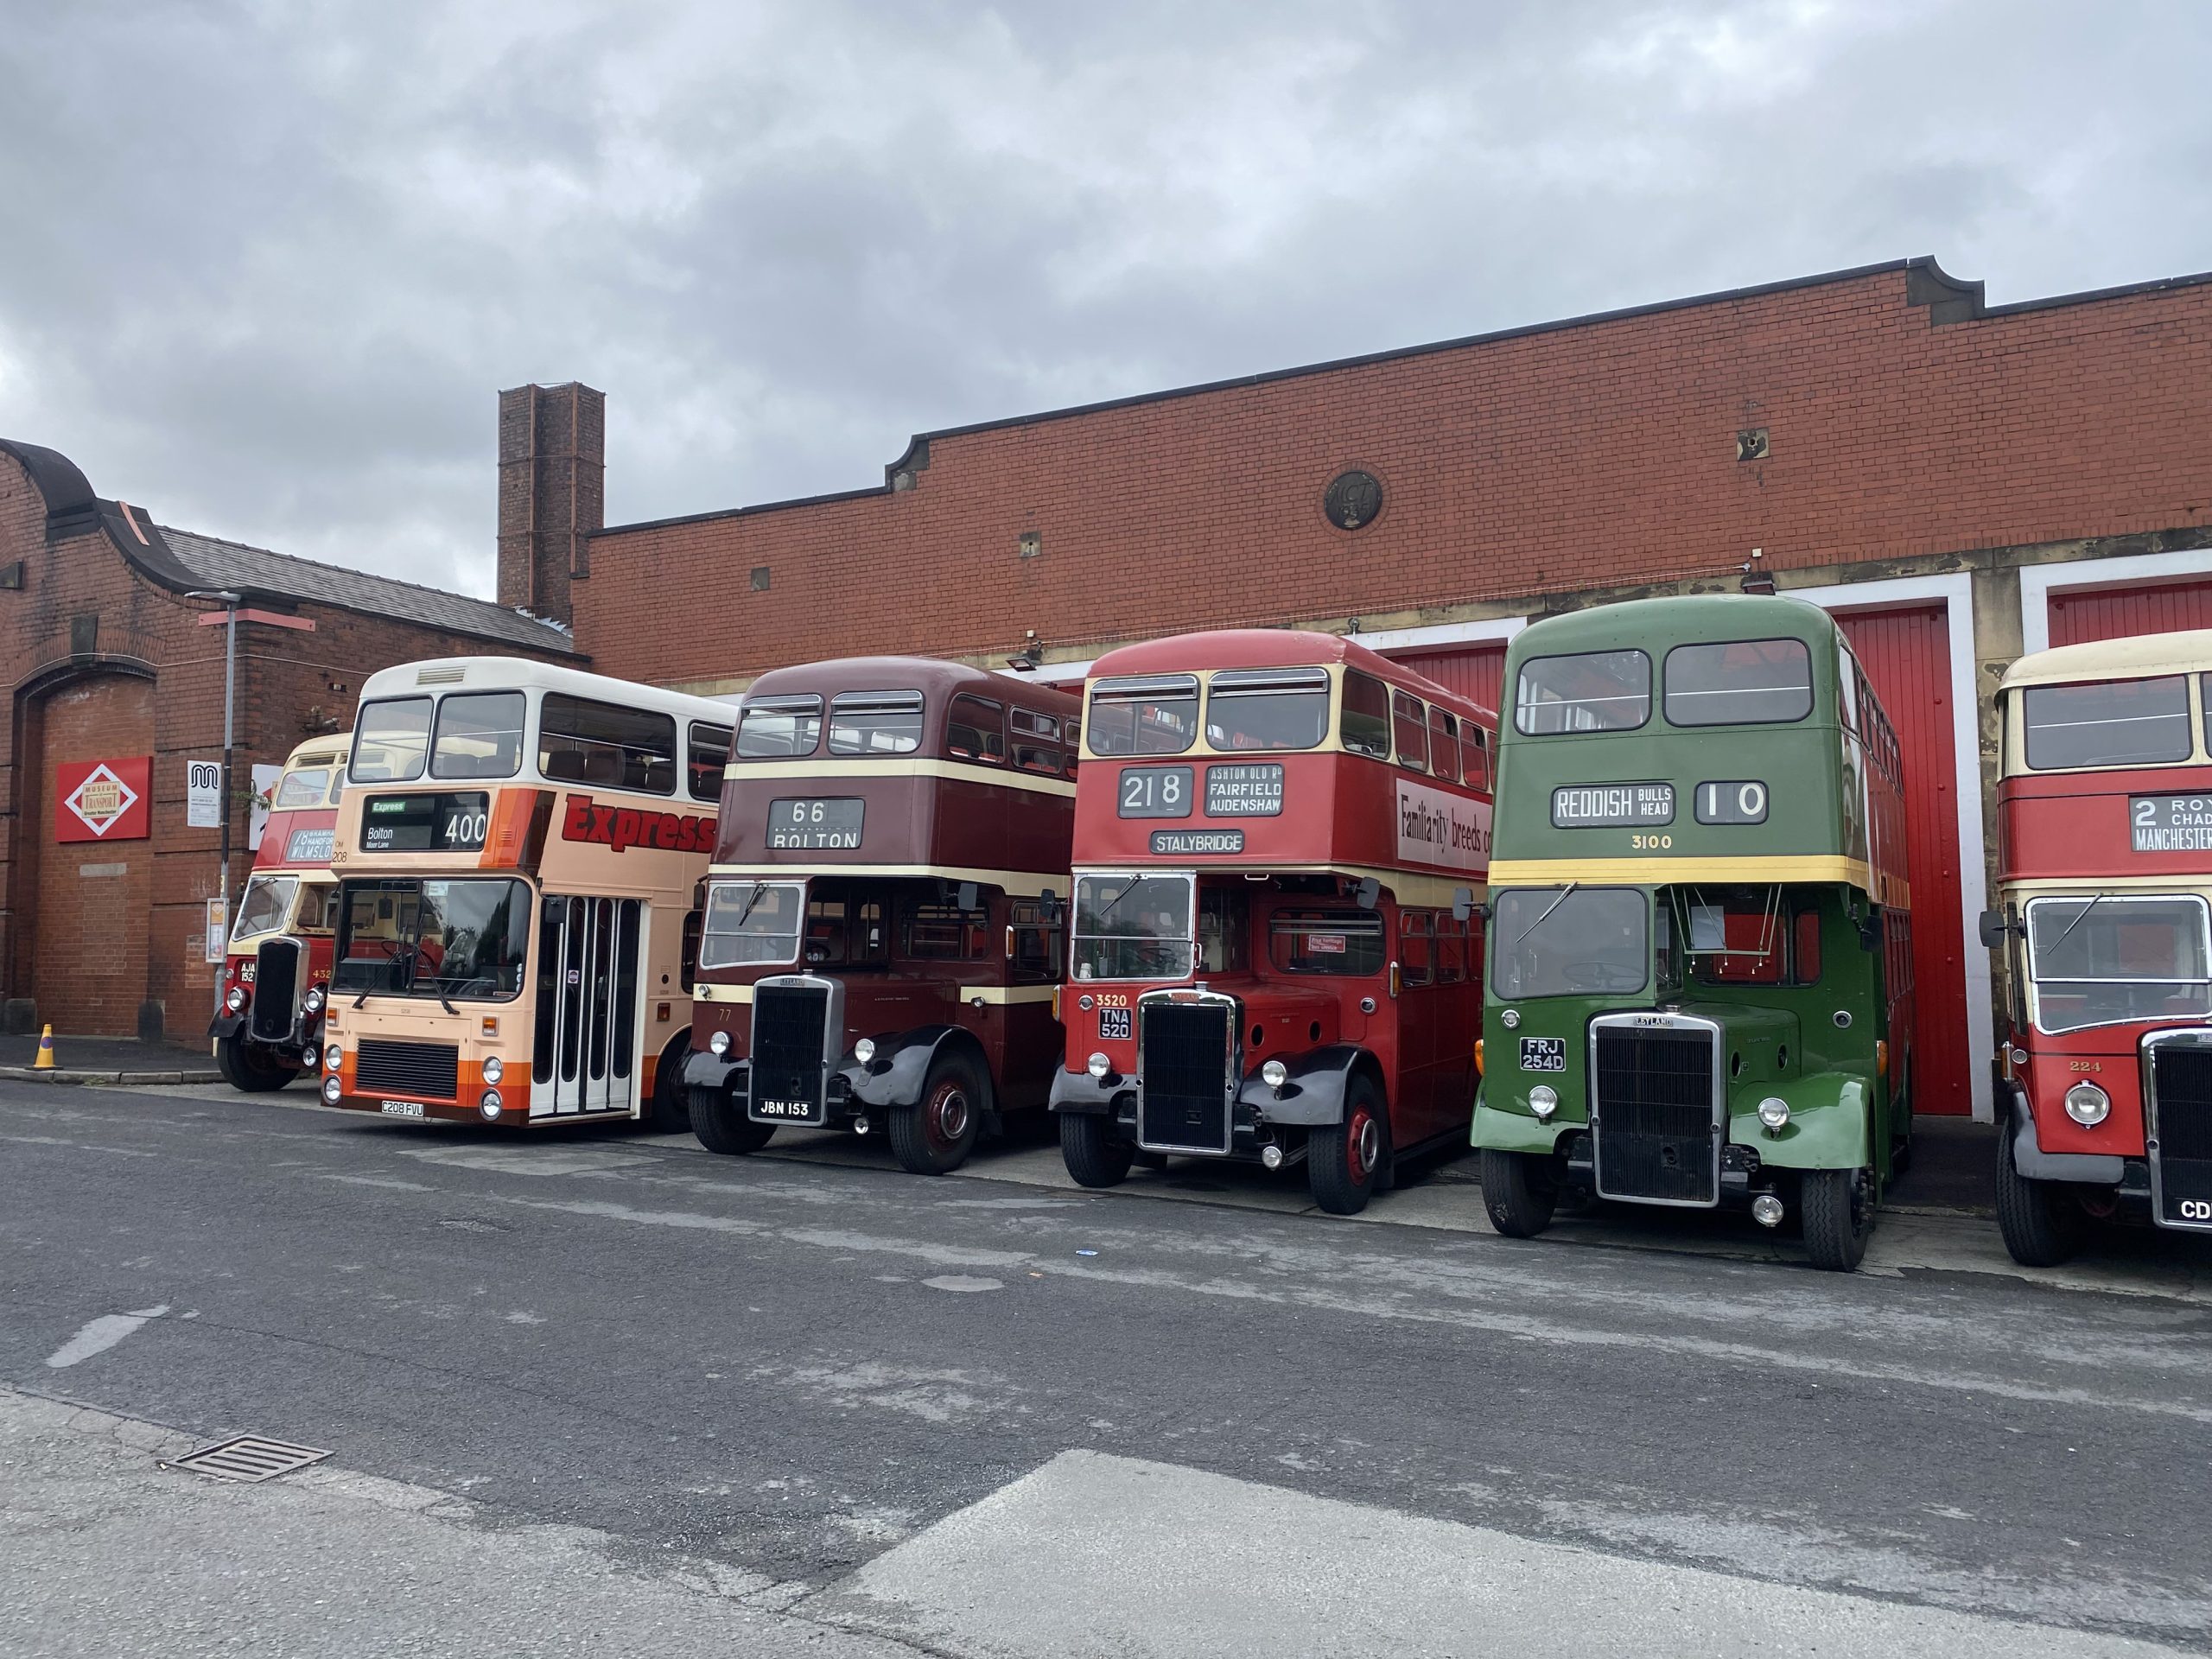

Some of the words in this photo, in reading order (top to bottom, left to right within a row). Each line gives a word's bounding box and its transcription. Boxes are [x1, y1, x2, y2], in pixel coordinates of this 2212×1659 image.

[1211, 767, 1245, 780] ASHTON
[1249, 766, 1268, 780] OLD
[85, 784, 118, 793] MUSEUM
[1124, 774, 1180, 808] 218
[1210, 782, 1282, 797] FAIRFIELD
[1637, 787, 1671, 802] BULLS
[85, 793, 118, 810] TRANSPORT
[372, 802, 404, 812] Express
[1210, 798, 1281, 812] AUDENSHAW
[1557, 789, 1632, 818] REDDISH
[792, 802, 824, 823] 66
[1640, 802, 1669, 817] HEAD
[2135, 800, 2157, 827] 2
[445, 814, 486, 842] 400
[563, 793, 717, 853] Express
[1401, 793, 1449, 854] Familiarity
[1452, 806, 1481, 852] breeds
[367, 827, 393, 840] Bolton
[378, 840, 390, 849] Lane
[1156, 835, 1243, 852] STALYBRIDGE
[1631, 835, 1672, 849] 3100
[241, 963, 256, 972] AJA
[313, 969, 332, 979] 432
[241, 972, 253, 982] 152
[1096, 994, 1128, 1007] 3520
[719, 1008, 732, 1021] 77
[1102, 1009, 1129, 1024] TNA
[1634, 1017, 1673, 1027] LEYLAND
[1102, 1023, 1128, 1038] 520
[1527, 1039, 1558, 1054] FRJ
[1522, 1055, 1563, 1070] 254D
[2069, 1061, 2102, 1072] 224
[382, 1102, 404, 1114] C208
[406, 1103, 423, 1116] FVU
[760, 1101, 785, 1115] JBN
[788, 1103, 809, 1116] 153
[2181, 1200, 2212, 1219] CD
